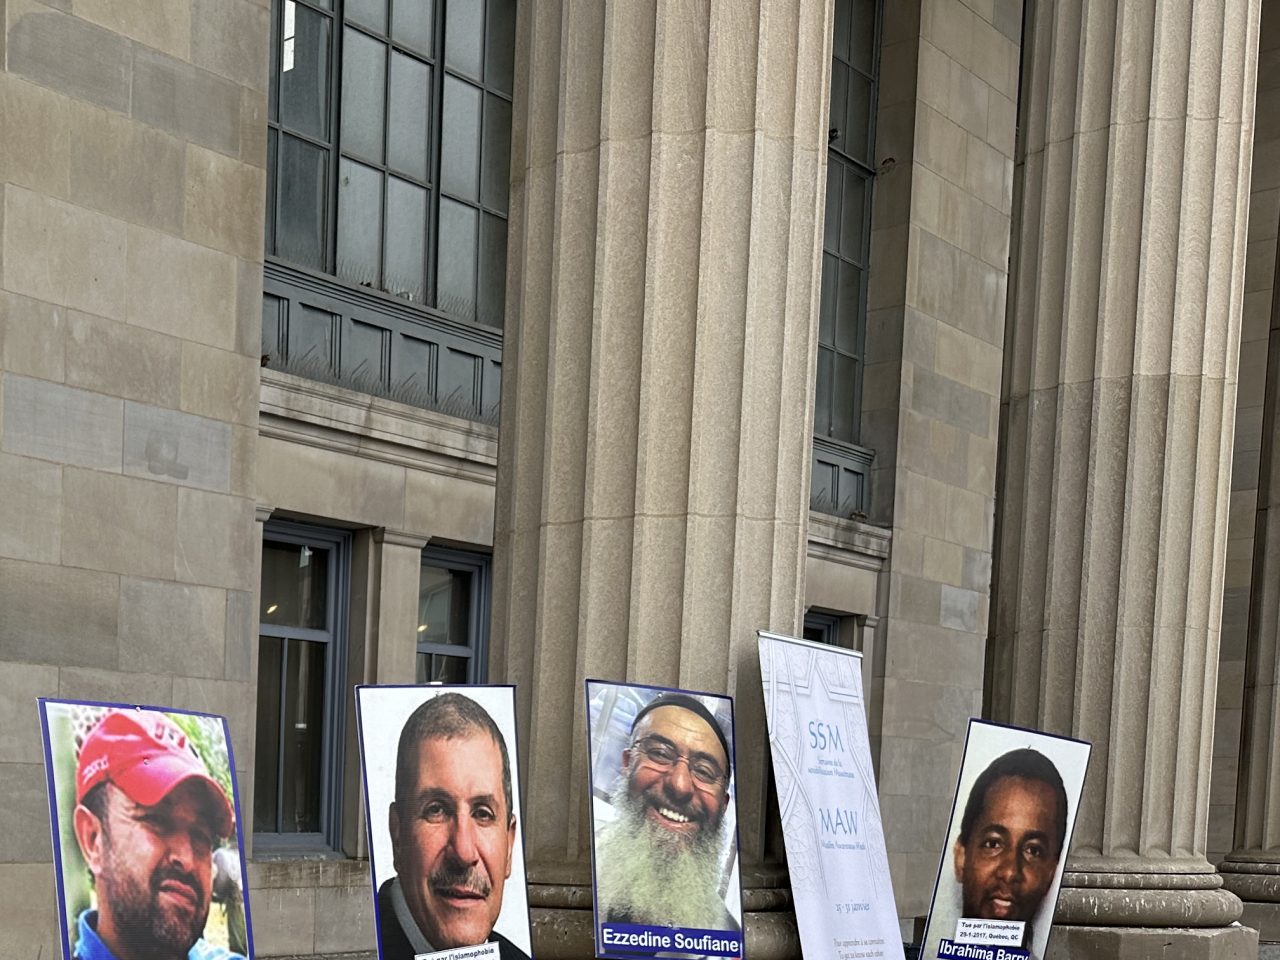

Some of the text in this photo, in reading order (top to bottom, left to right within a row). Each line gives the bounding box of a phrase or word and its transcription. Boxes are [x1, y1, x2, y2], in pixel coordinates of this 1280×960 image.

[808, 720, 844, 752] SSM
[819, 807, 858, 835] MAW
[603, 928, 739, 952] Ezzedine Soufiane
[939, 940, 993, 960] Ibrahima
[449, 948, 494, 960] l'islamophobie
